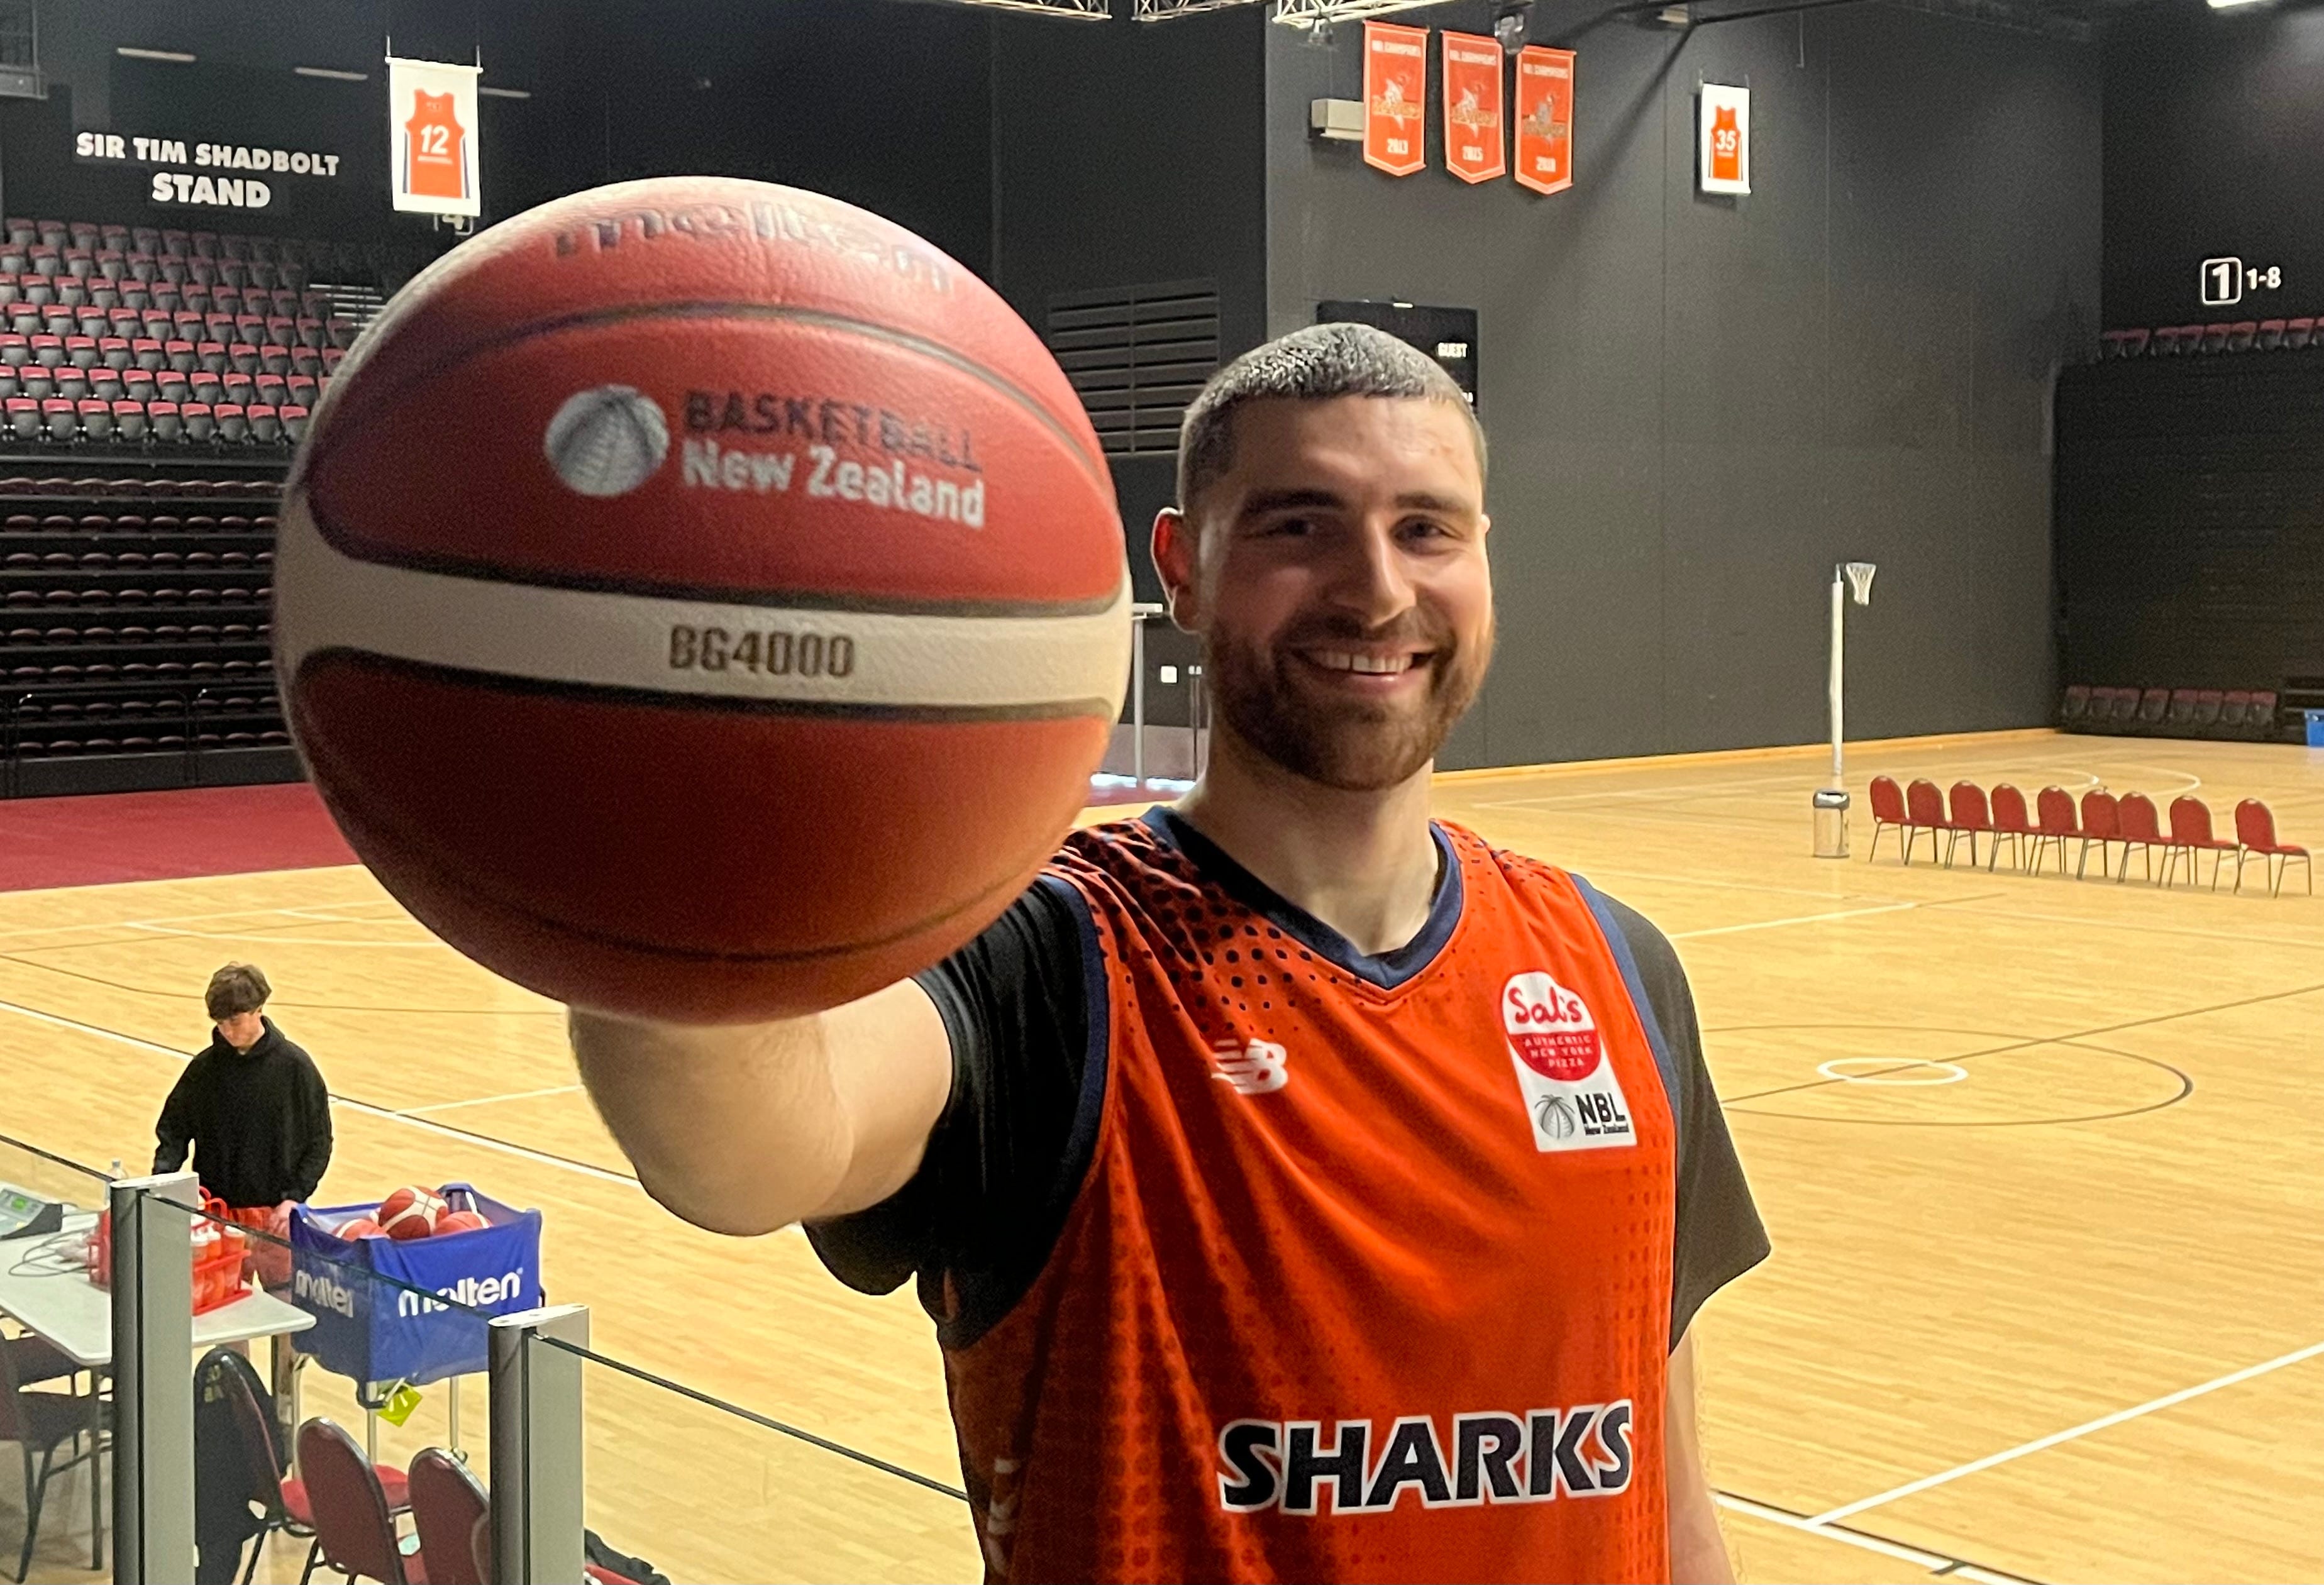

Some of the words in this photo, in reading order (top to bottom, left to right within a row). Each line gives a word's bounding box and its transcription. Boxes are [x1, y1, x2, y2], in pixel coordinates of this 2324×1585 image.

[76, 132, 126, 159] SIR
[133, 137, 187, 164] TIM
[195, 143, 340, 176] SHADBOLT
[420, 124, 450, 155] 12
[1715, 129, 1737, 151] 35
[152, 172, 271, 208] STAND
[2212, 263, 2230, 299] 1
[2247, 266, 2282, 290] 1-8
[683, 390, 982, 473] BASKETBALL
[682, 439, 794, 492] New
[807, 443, 985, 530] Zealand
[670, 624, 855, 677] BG4000
[1508, 986, 1582, 1024] Sal's
[1524, 1035, 1592, 1047] AUTHENTIC
[1530, 1048, 1556, 1058] NEW
[1563, 1046, 1593, 1055] YORK
[1547, 1057, 1585, 1068] PIZZA
[1575, 1092, 1627, 1124] NBL
[398, 1271, 521, 1318] molten
[1217, 1399, 1633, 1515] SHARKS
